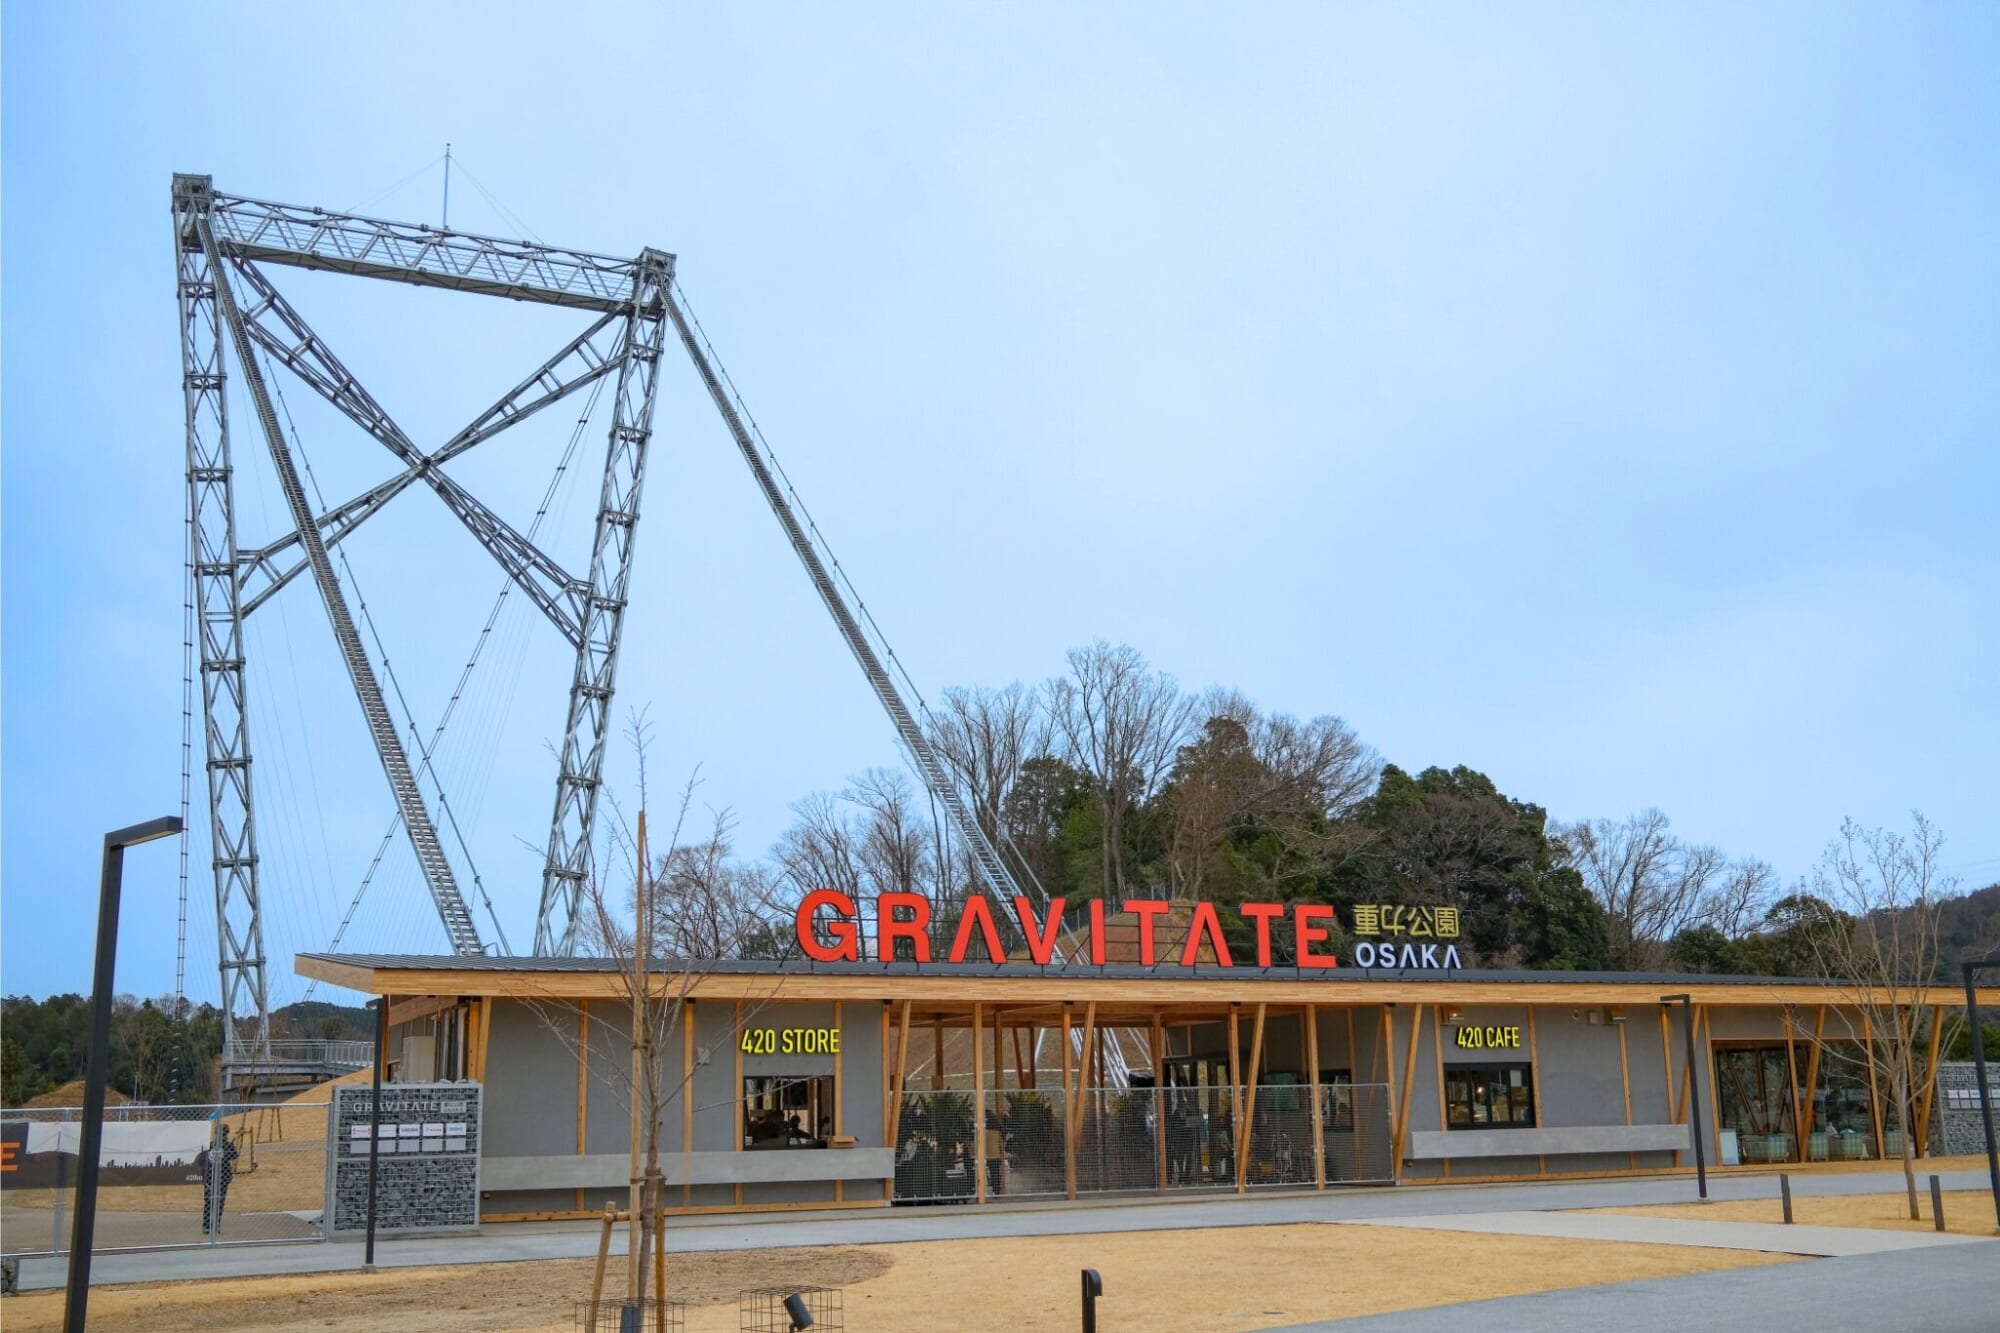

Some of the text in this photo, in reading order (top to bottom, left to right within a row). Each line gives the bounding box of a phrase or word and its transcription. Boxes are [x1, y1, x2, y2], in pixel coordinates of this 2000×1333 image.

[796, 889, 1337, 969] GRAVITATE
[1355, 942, 1462, 969] OSAKA
[741, 1028, 840, 1054] 420 STORE
[1457, 1026, 1521, 1048] 420 CAFE
